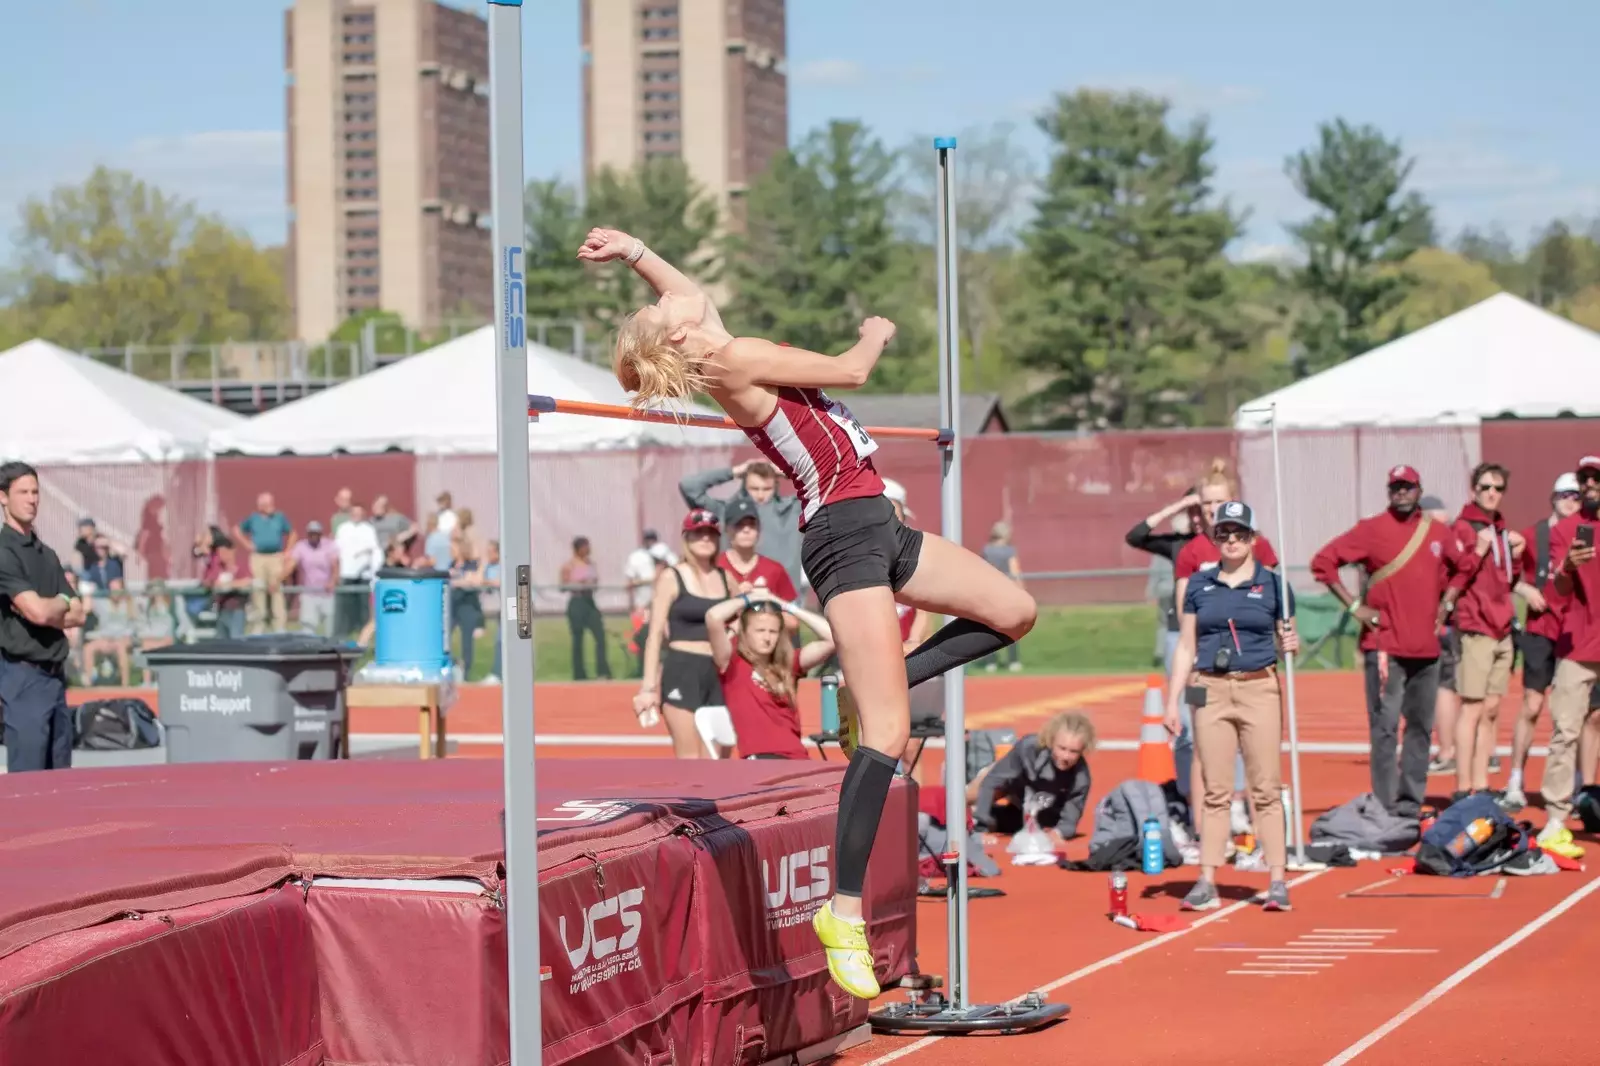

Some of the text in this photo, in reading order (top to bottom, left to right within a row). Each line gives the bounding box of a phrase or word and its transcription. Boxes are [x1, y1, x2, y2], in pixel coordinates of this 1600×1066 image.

[508, 246, 524, 348] UCS
[851, 419, 872, 445] 3
[186, 669, 242, 692] Trash Only!
[180, 694, 252, 716] Event Support
[762, 845, 831, 909] UCS
[559, 886, 646, 970] UCS
